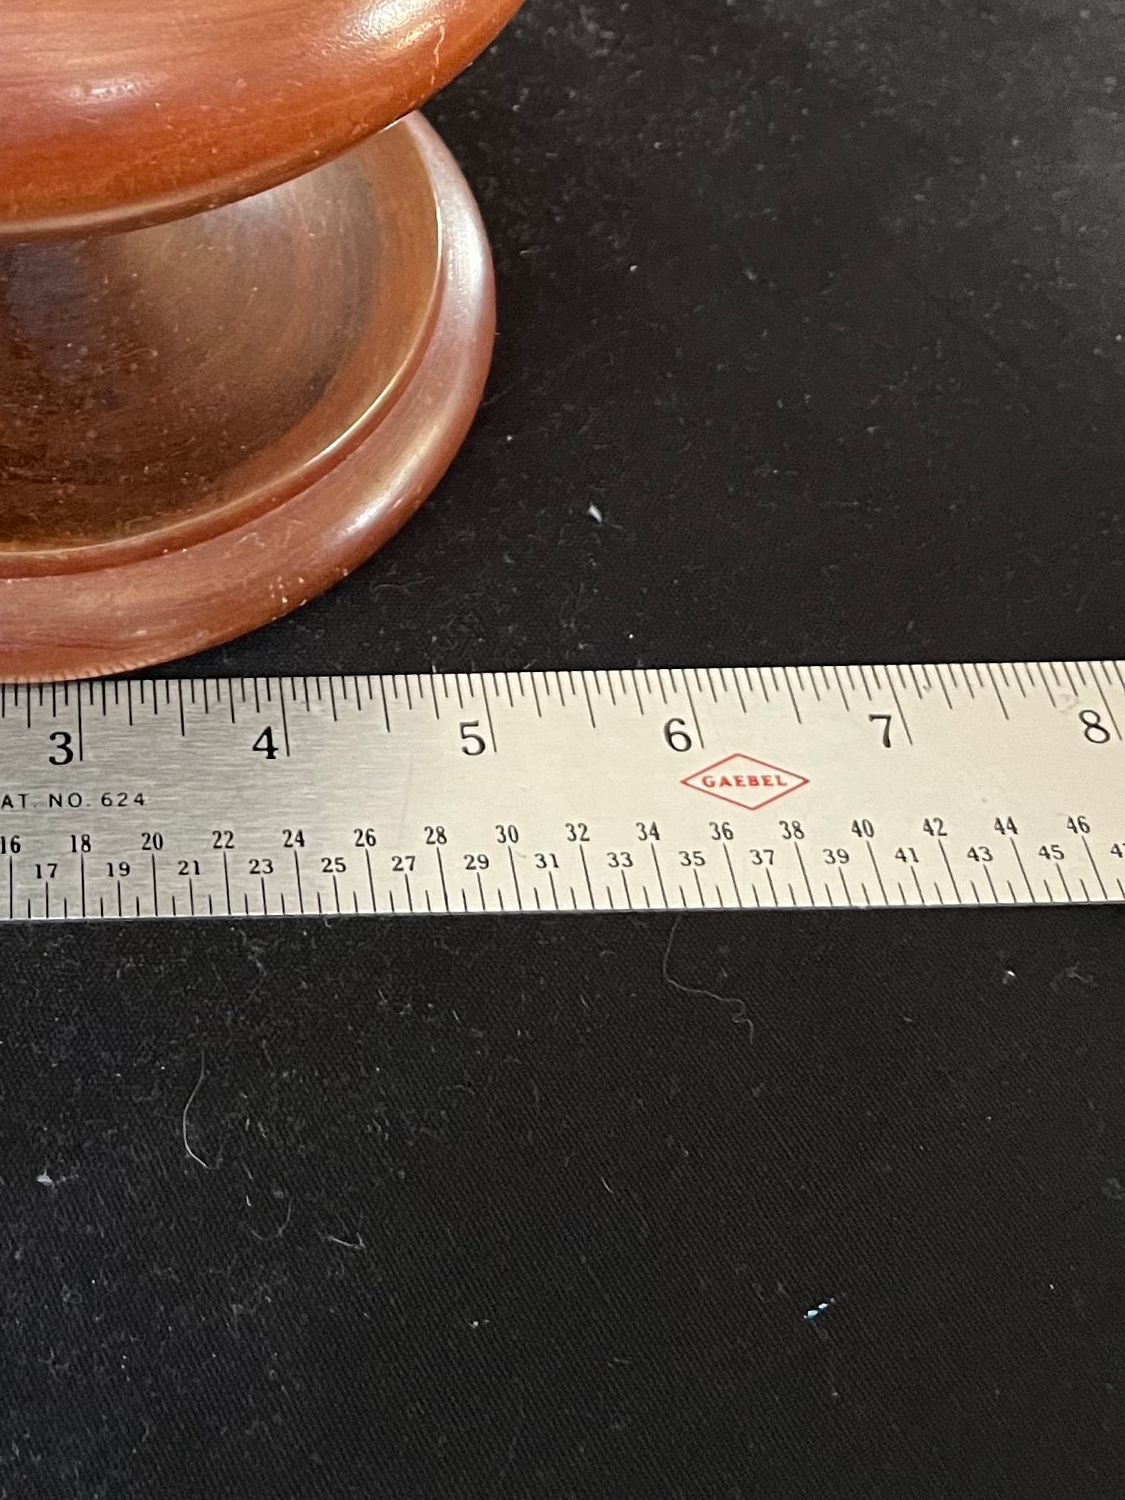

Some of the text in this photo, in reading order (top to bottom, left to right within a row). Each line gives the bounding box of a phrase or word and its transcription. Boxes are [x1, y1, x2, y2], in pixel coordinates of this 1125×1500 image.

[48, 731, 74, 766] 3
[252, 726, 279, 760] 4
[459, 720, 486, 756] 5
[663, 718, 692, 752] 6
[868, 713, 892, 748] 7
[1078, 709, 1111, 744] 8
[701, 775, 788, 788] GAEBEL
[48, 792, 91, 808] NO.
[101, 792, 146, 808] 624
[0, 836, 21, 854] 16
[71, 834, 92, 853] 18
[141, 832, 164, 851] 20
[212, 831, 235, 849] 22
[283, 829, 306, 848] 24
[354, 828, 377, 847] 26
[424, 826, 447, 845] 28
[496, 824, 519, 843] 30
[566, 823, 590, 842] 32
[636, 822, 661, 841] 34
[709, 822, 734, 841] 36
[779, 821, 805, 840] 38
[851, 819, 874, 838] 40
[923, 818, 948, 837] 42
[994, 817, 1019, 835] 44
[1066, 816, 1091, 834] 46
[34, 863, 58, 879] 17
[106, 862, 131, 877] 19
[177, 861, 201, 876] 21
[248, 859, 274, 874] 23
[321, 858, 346, 873] 25
[391, 857, 416, 872] 27
[463, 855, 489, 870] 29
[534, 854, 559, 869] 31
[606, 852, 634, 868] 33
[678, 852, 706, 866] 35
[749, 850, 774, 866] 37
[823, 849, 850, 864] 39
[894, 848, 919, 863] 41
[967, 847, 994, 862] 43
[1038, 845, 1065, 860] 45
[1109, 843, 1125, 858] 4
